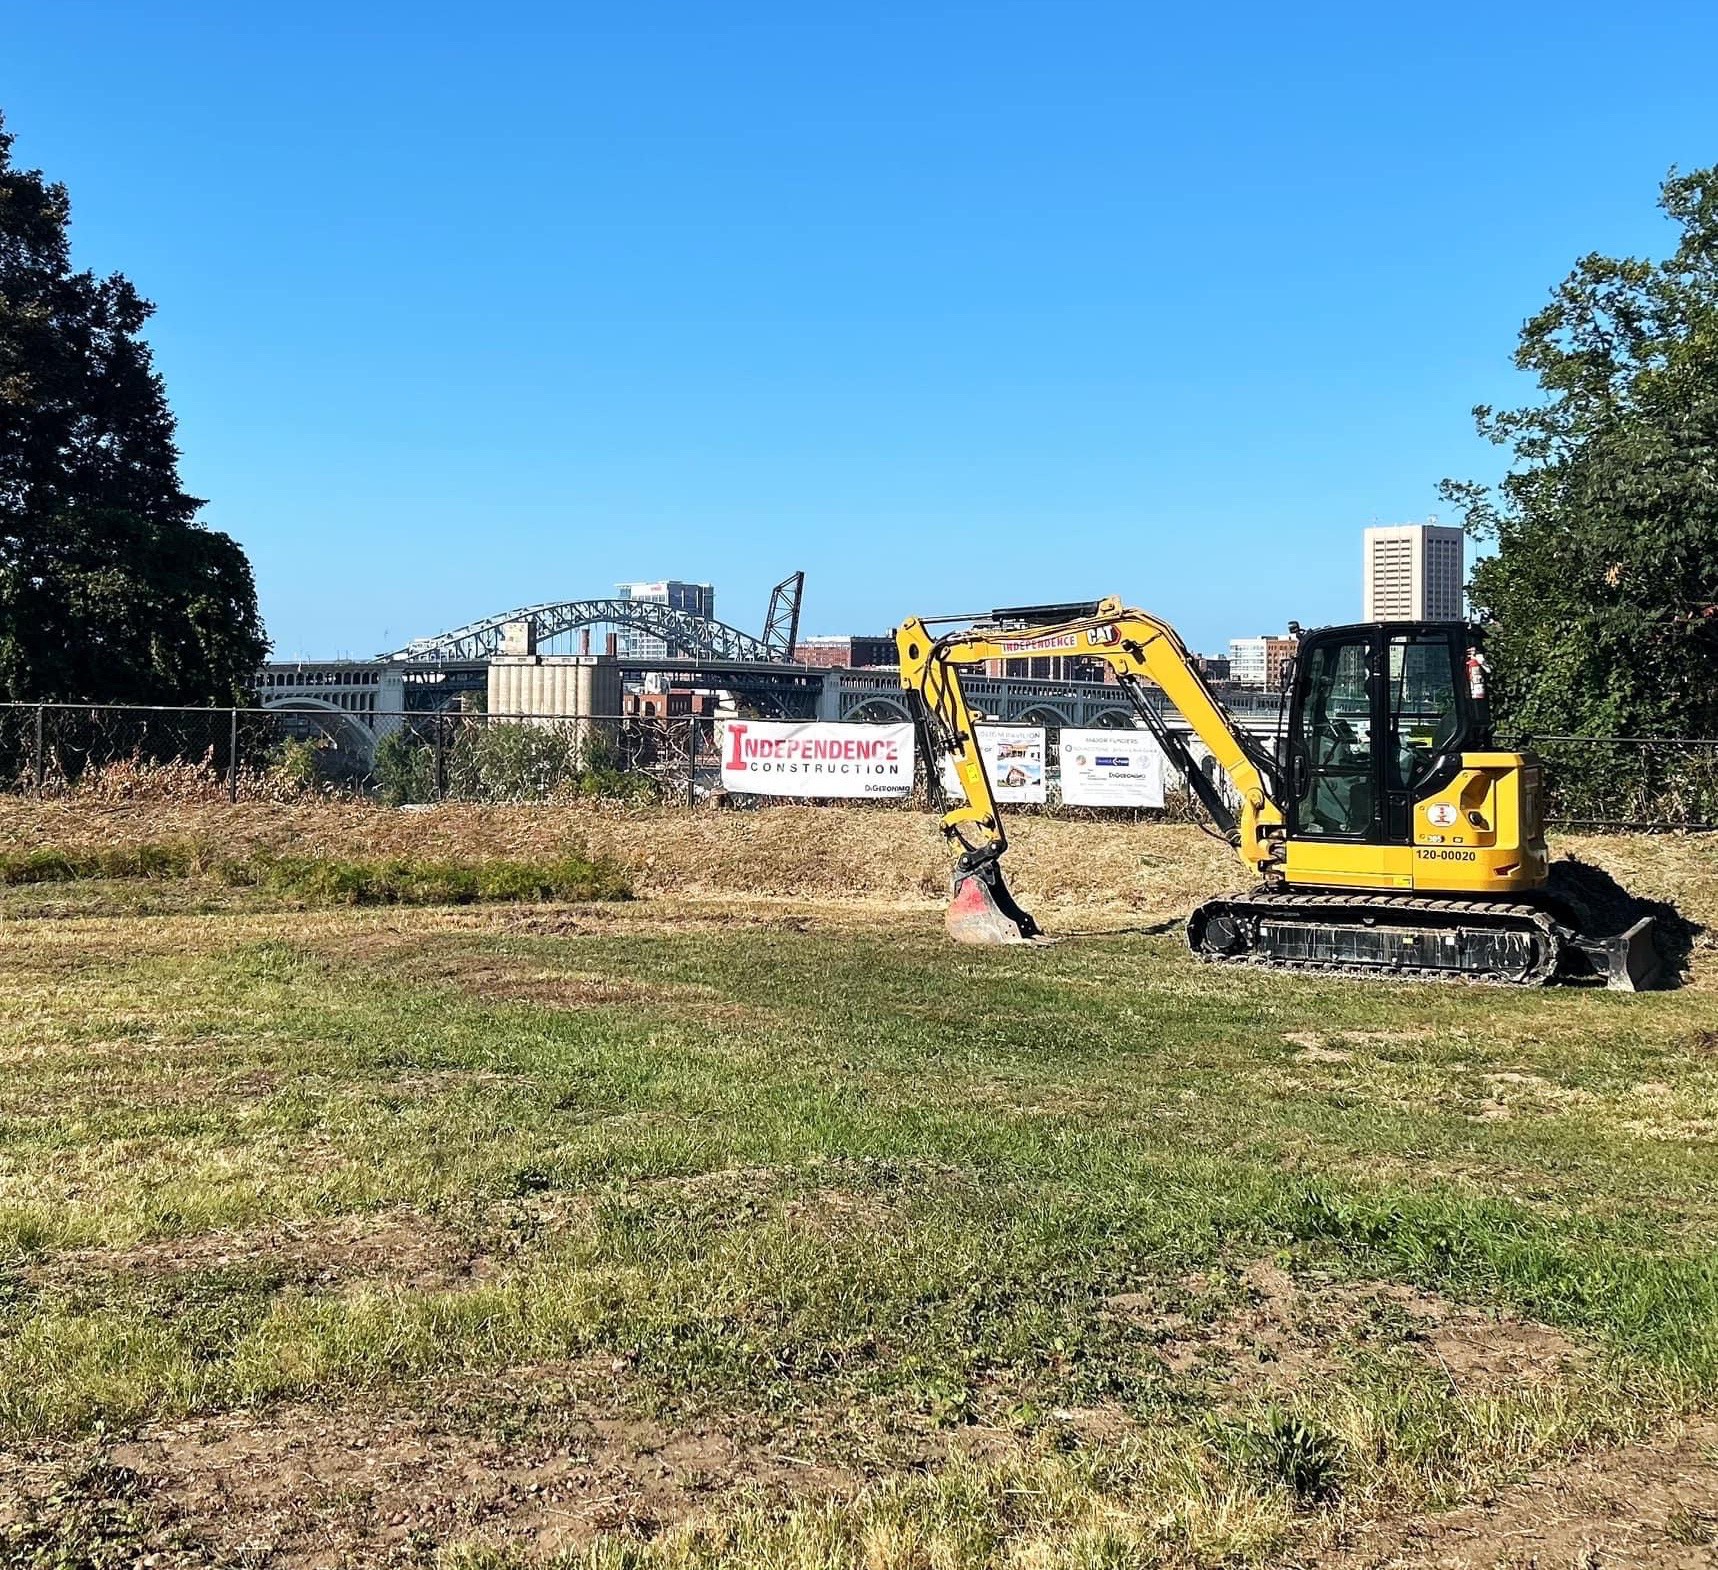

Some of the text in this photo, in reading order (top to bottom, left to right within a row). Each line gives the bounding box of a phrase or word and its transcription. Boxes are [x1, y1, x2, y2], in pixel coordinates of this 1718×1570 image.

[1087, 624, 1113, 646] CAT
[1002, 636, 1076, 652] INDEPENDENCE
[726, 724, 899, 771] INDEPENDENCE
[750, 762, 899, 775] CONSTRUCTION
[1416, 849, 1476, 862] 120-00020
